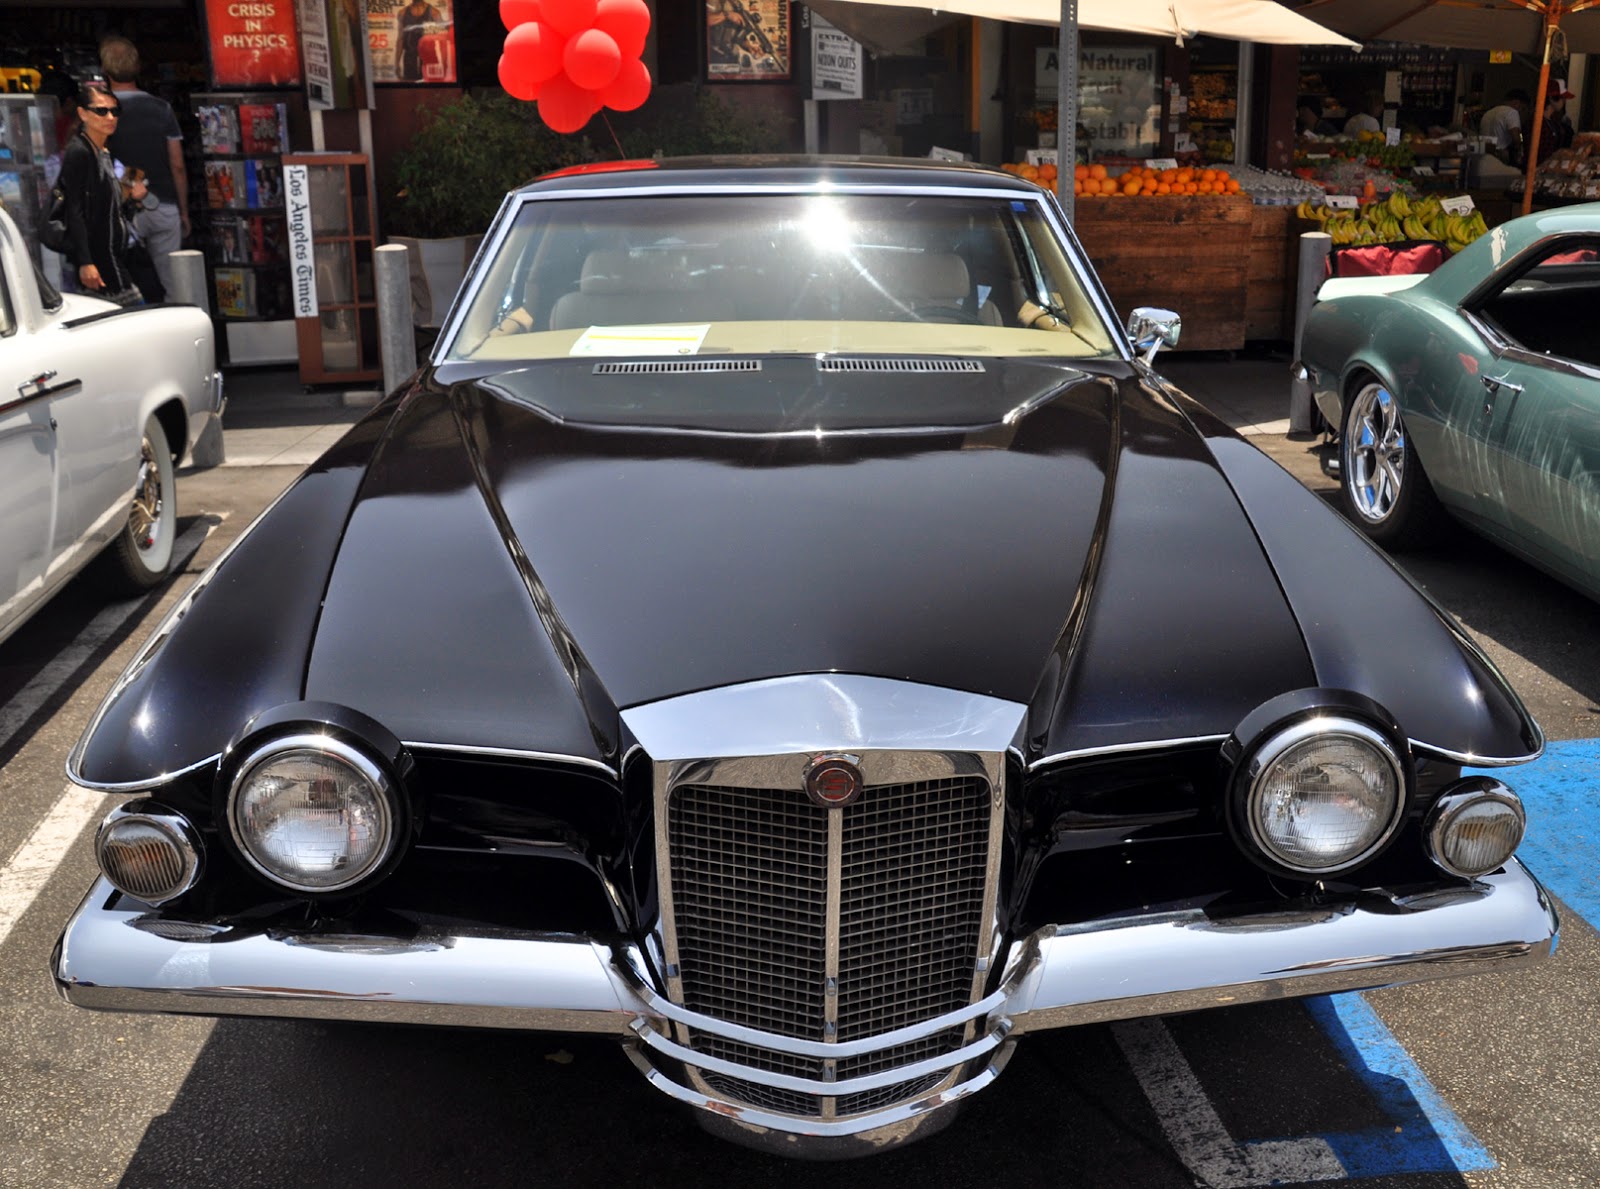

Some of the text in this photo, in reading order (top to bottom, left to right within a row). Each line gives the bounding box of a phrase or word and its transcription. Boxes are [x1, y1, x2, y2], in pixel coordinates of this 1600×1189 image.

[228, 3, 276, 17] CRISIS
[245, 19, 262, 32] IN
[223, 34, 288, 49] PHYSICS
[369, 33, 389, 49] 25
[818, 33, 850, 42] EXTRA
[251, 49, 261, 63] ?
[836, 54, 857, 71] QUITS
[1081, 52, 1154, 71] Natural
[1077, 75, 1123, 95] Fruit
[289, 168, 313, 314] Los Angeles Times
